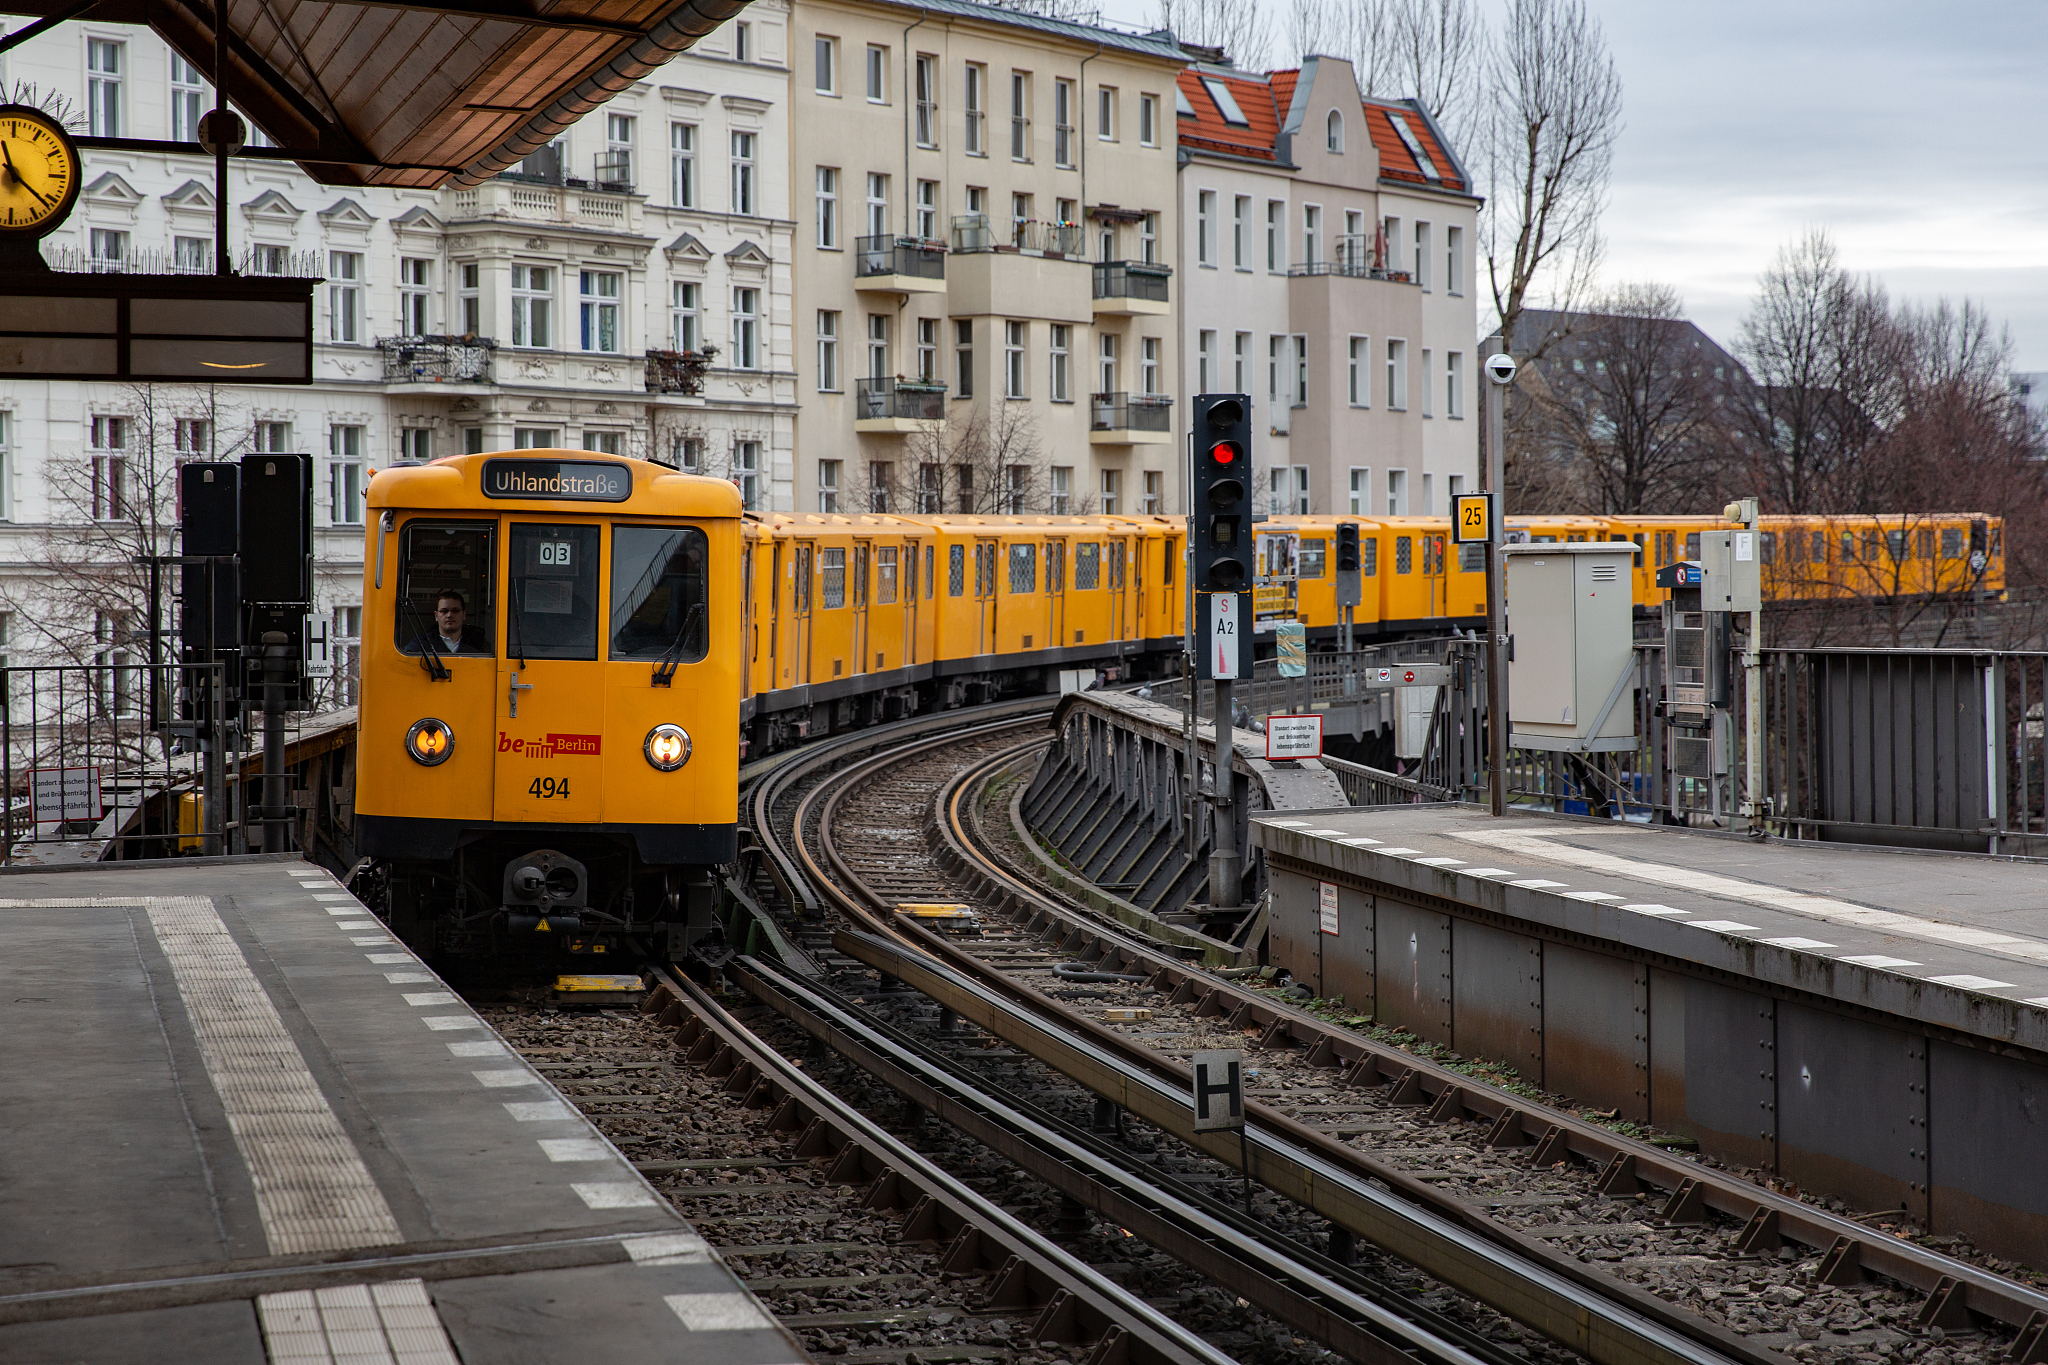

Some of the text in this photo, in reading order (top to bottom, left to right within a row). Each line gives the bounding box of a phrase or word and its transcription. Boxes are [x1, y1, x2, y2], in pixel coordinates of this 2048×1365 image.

[496, 471, 618, 494] Uhlandstraße
[1465, 507, 1481, 525] 25
[1741, 536, 1748, 549] F
[542, 547, 568, 561] 03
[1221, 599, 1229, 612] S
[307, 621, 327, 660] H
[498, 732, 595, 753] be Berlin
[529, 777, 570, 799] 494
[1197, 1062, 1241, 1119] H
